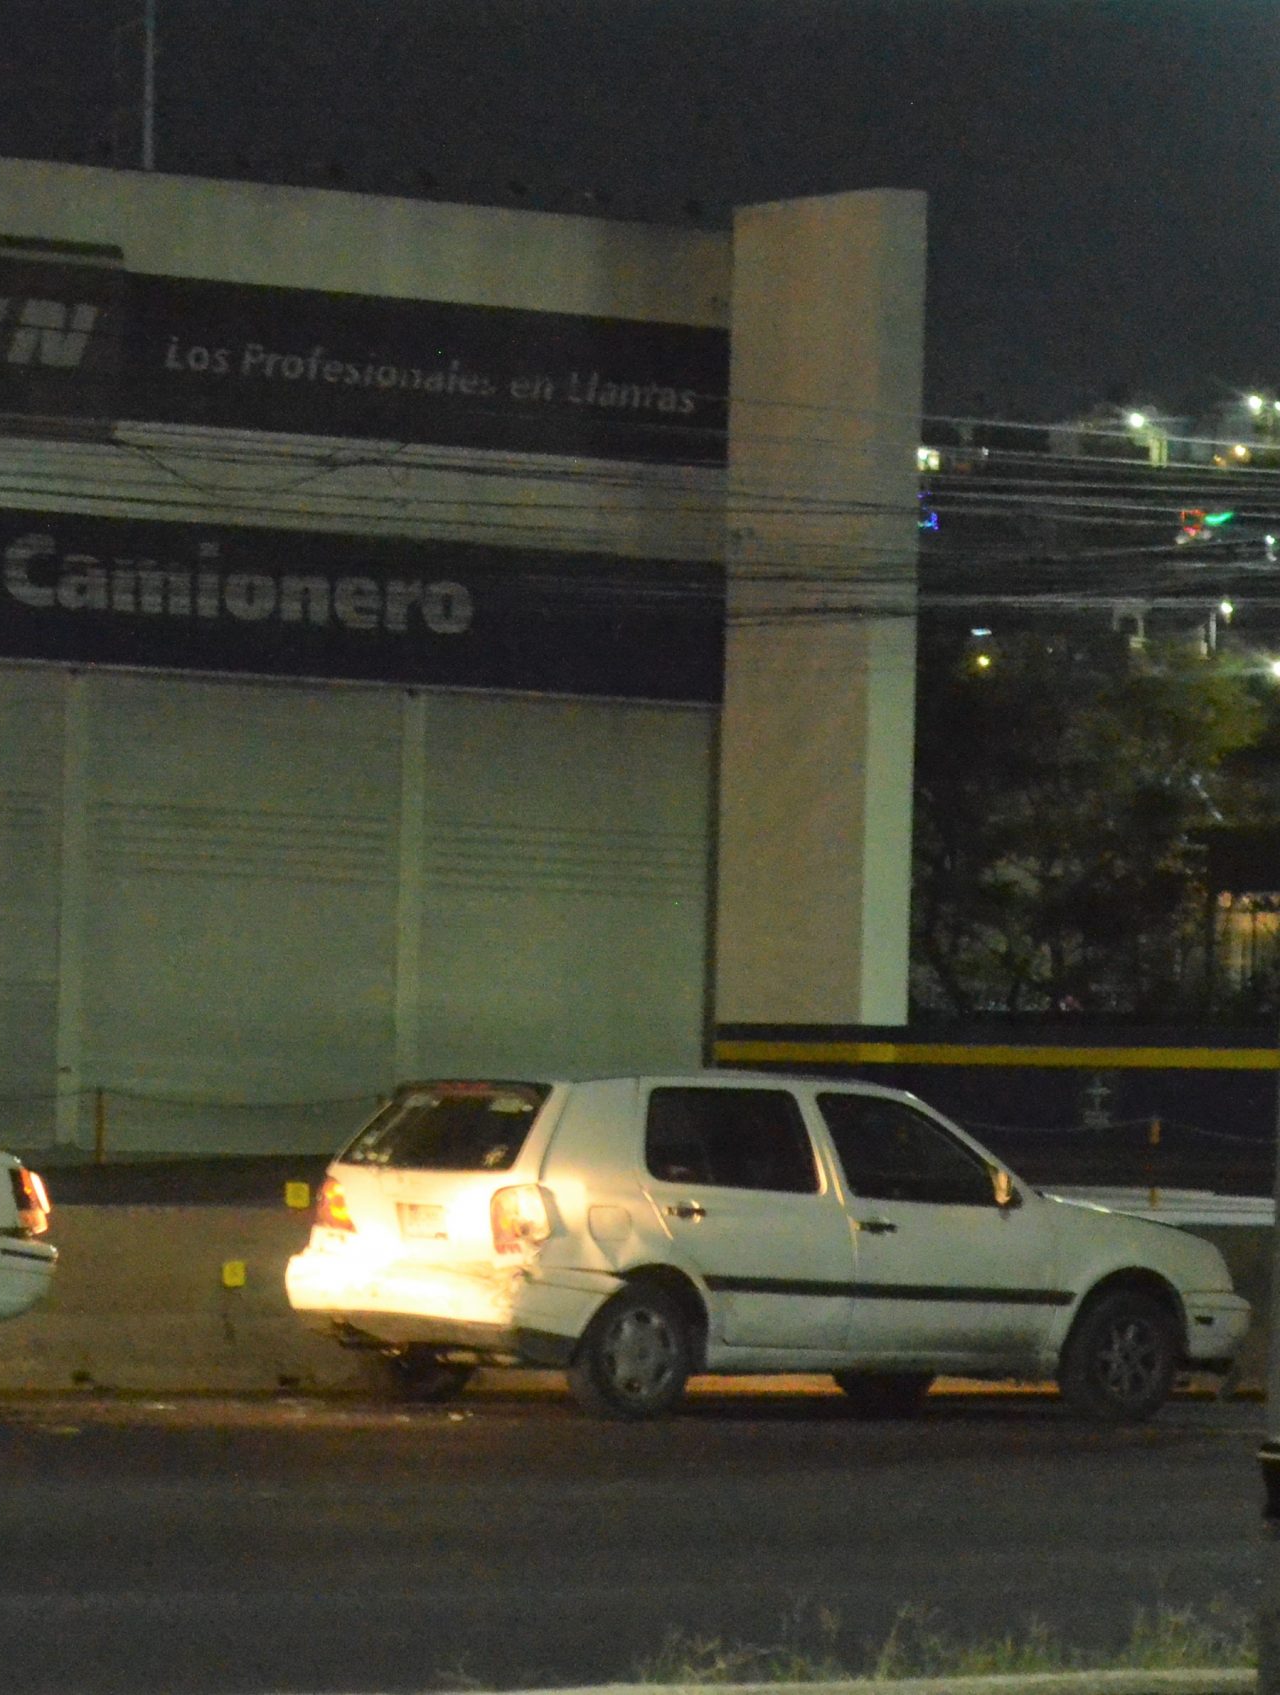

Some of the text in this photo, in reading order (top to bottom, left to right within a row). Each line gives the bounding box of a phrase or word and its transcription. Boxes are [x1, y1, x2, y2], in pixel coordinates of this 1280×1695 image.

[164, 336, 698, 415] Los Profesionales en Llantas
[2, 534, 476, 634] Camionero
